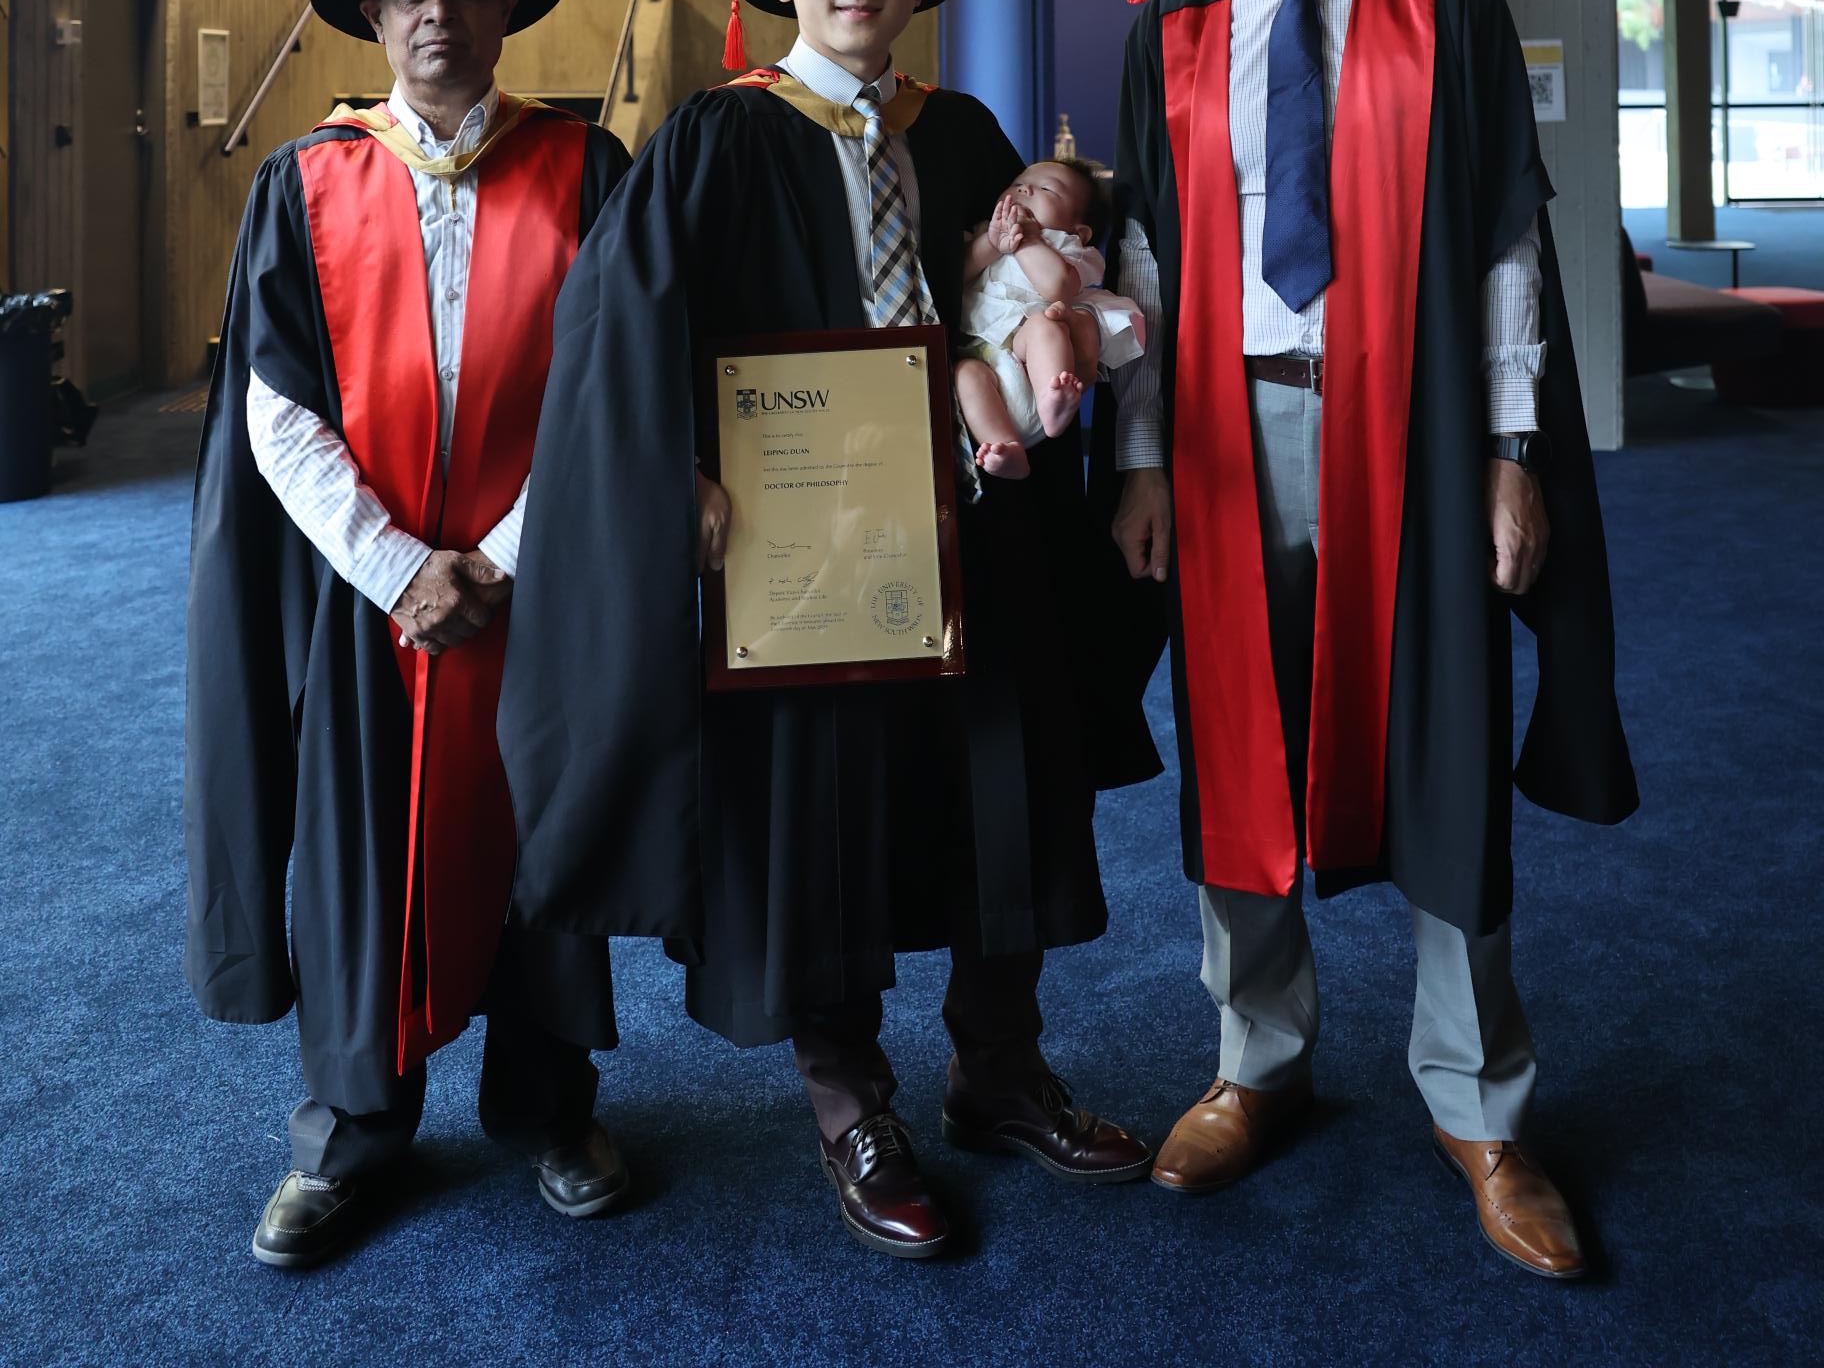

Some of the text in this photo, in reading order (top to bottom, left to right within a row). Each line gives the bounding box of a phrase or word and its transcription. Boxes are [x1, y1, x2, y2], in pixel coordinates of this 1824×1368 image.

[760, 390, 830, 410] UNSW
[764, 479, 849, 490] DOCTOR OF PHILOSOPHY
